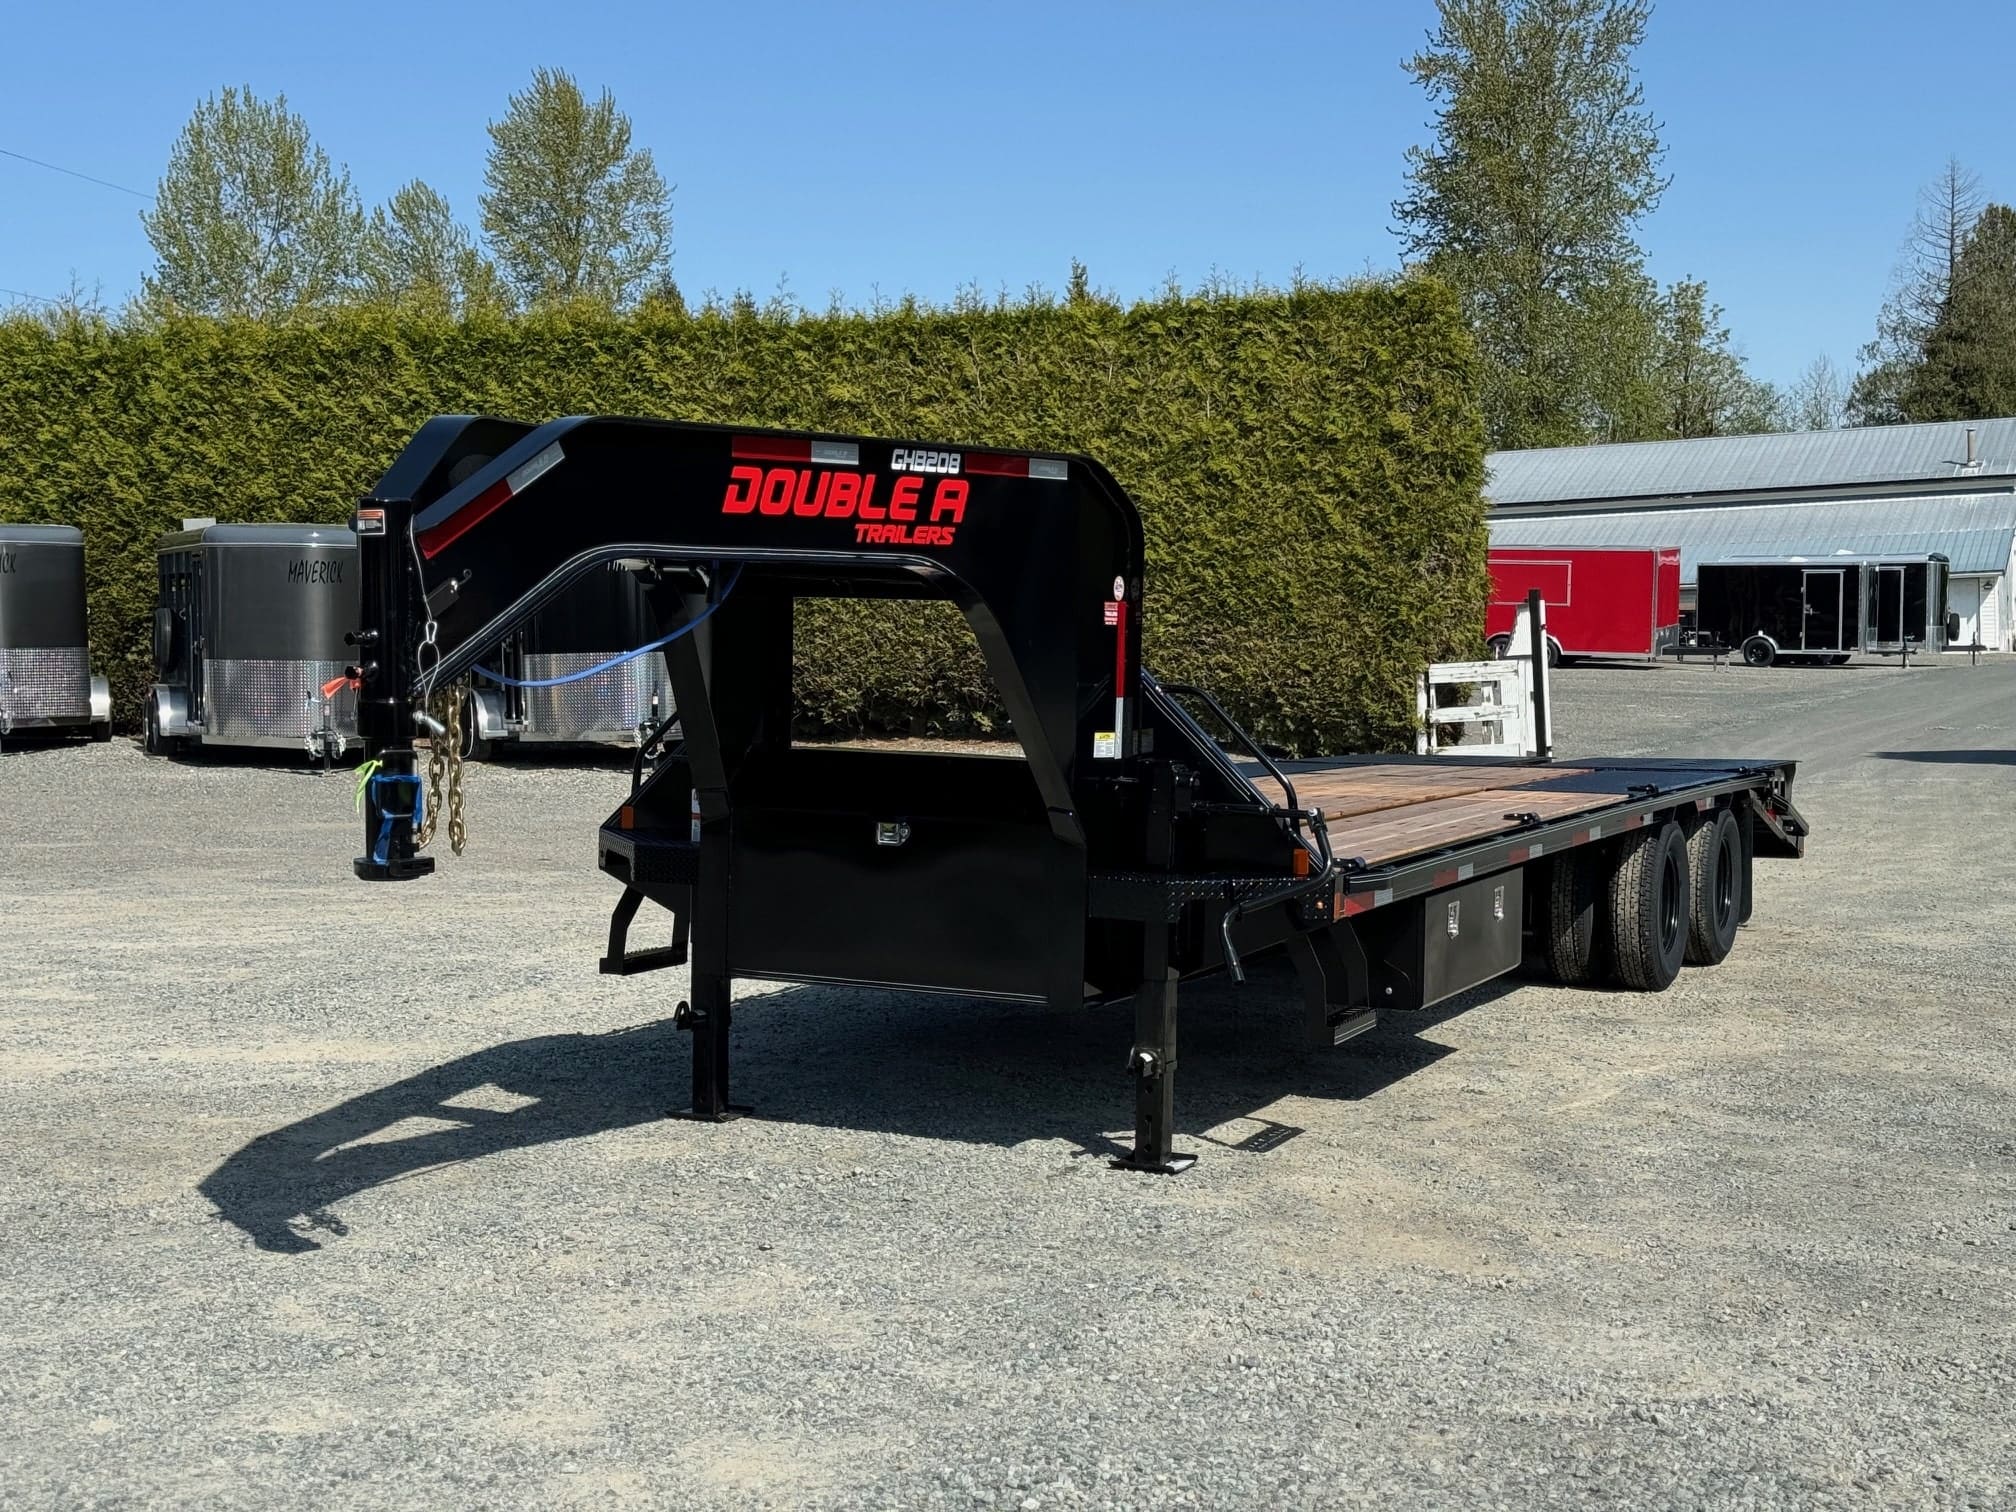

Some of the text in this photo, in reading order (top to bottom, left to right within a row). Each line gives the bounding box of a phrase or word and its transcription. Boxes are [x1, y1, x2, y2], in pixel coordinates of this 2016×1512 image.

[722, 465, 969, 523] DOUBLE A
[854, 523, 956, 545] TRAILERS
[288, 560, 343, 584] MAVERICK
